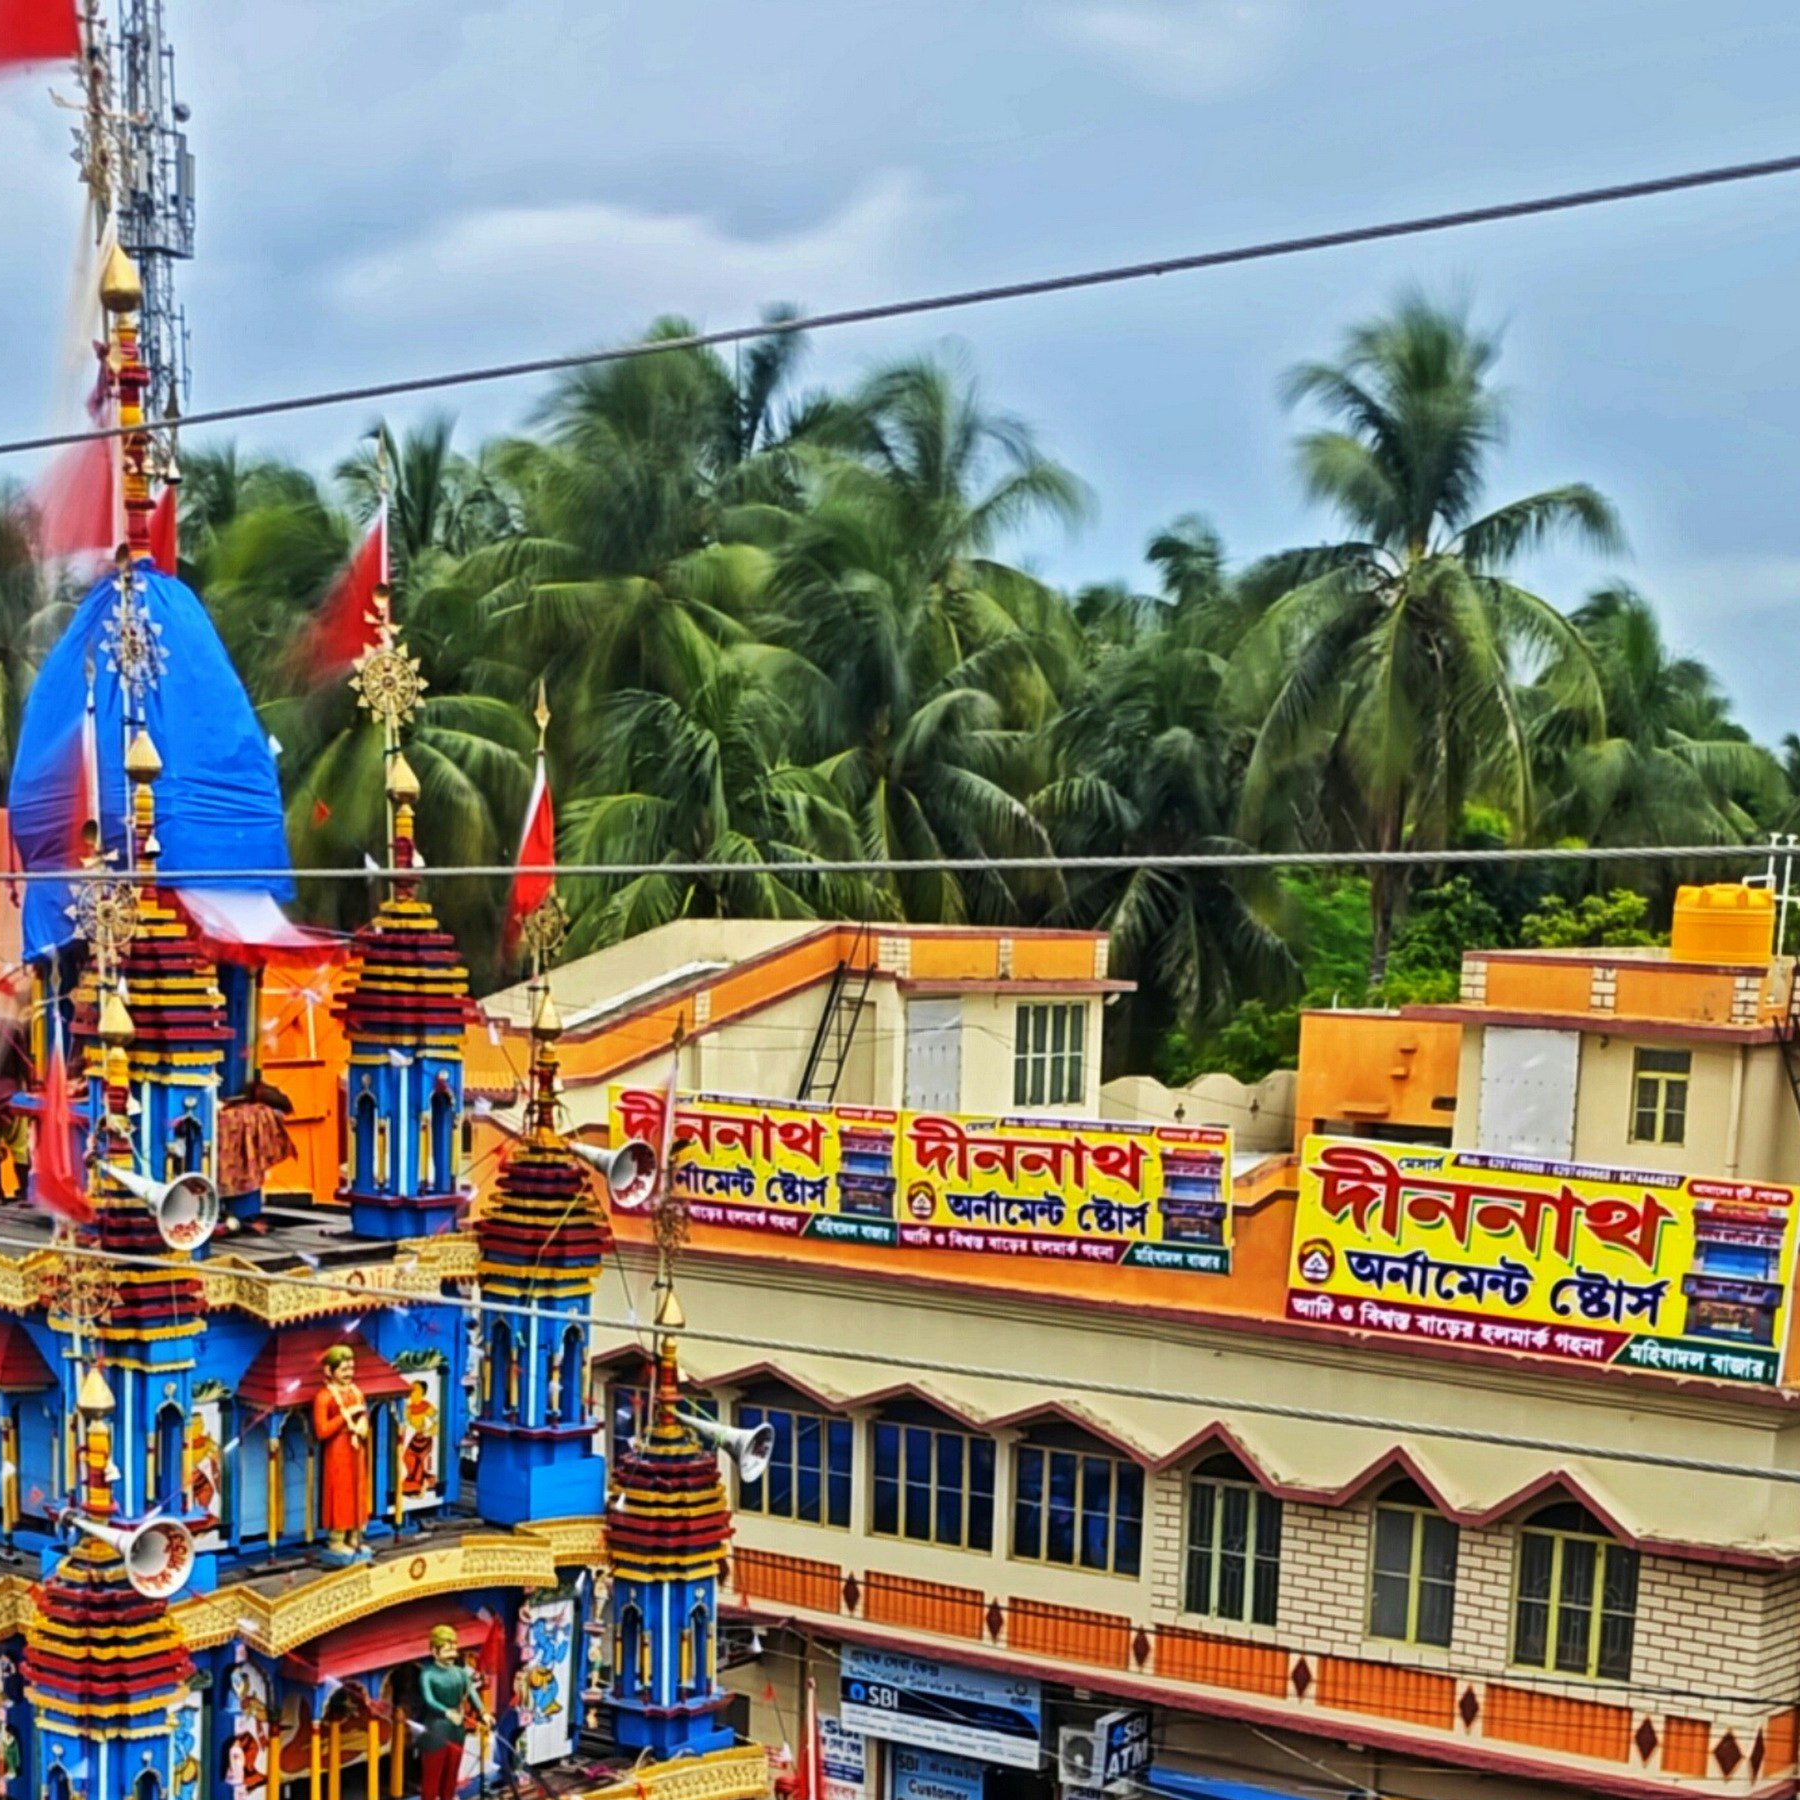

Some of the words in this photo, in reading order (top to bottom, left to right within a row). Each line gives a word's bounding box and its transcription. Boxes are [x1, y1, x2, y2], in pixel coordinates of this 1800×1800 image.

[906, 1117, 1148, 1194] দীননাথ
[674, 1161, 755, 1198] র্নামেন্ট
[946, 1189, 1065, 1227] অর্নামেন্ট
[1309, 1146, 1674, 1268] দীননাথ
[1344, 1250, 1535, 1307] অর্নামেন্ট
[1291, 1295, 1334, 1320] আদি
[1338, 1305, 1354, 1322] ও
[1359, 1302, 1411, 1330] বিশ্বস্ত
[1416, 1314, 1476, 1340] বাড়ের
[1479, 1323, 1549, 1350] হলমার্ক
[1553, 1331, 1605, 1358] গহনা
[1629, 1339, 1707, 1372] মহিষাদল
[1710, 1350, 1765, 1380] বাজার
[868, 1685, 900, 1711] SBI
[1123, 1714, 1148, 1742] SBI
[898, 1753, 920, 1772] SBI
[1106, 1742, 1149, 1780] ATM
